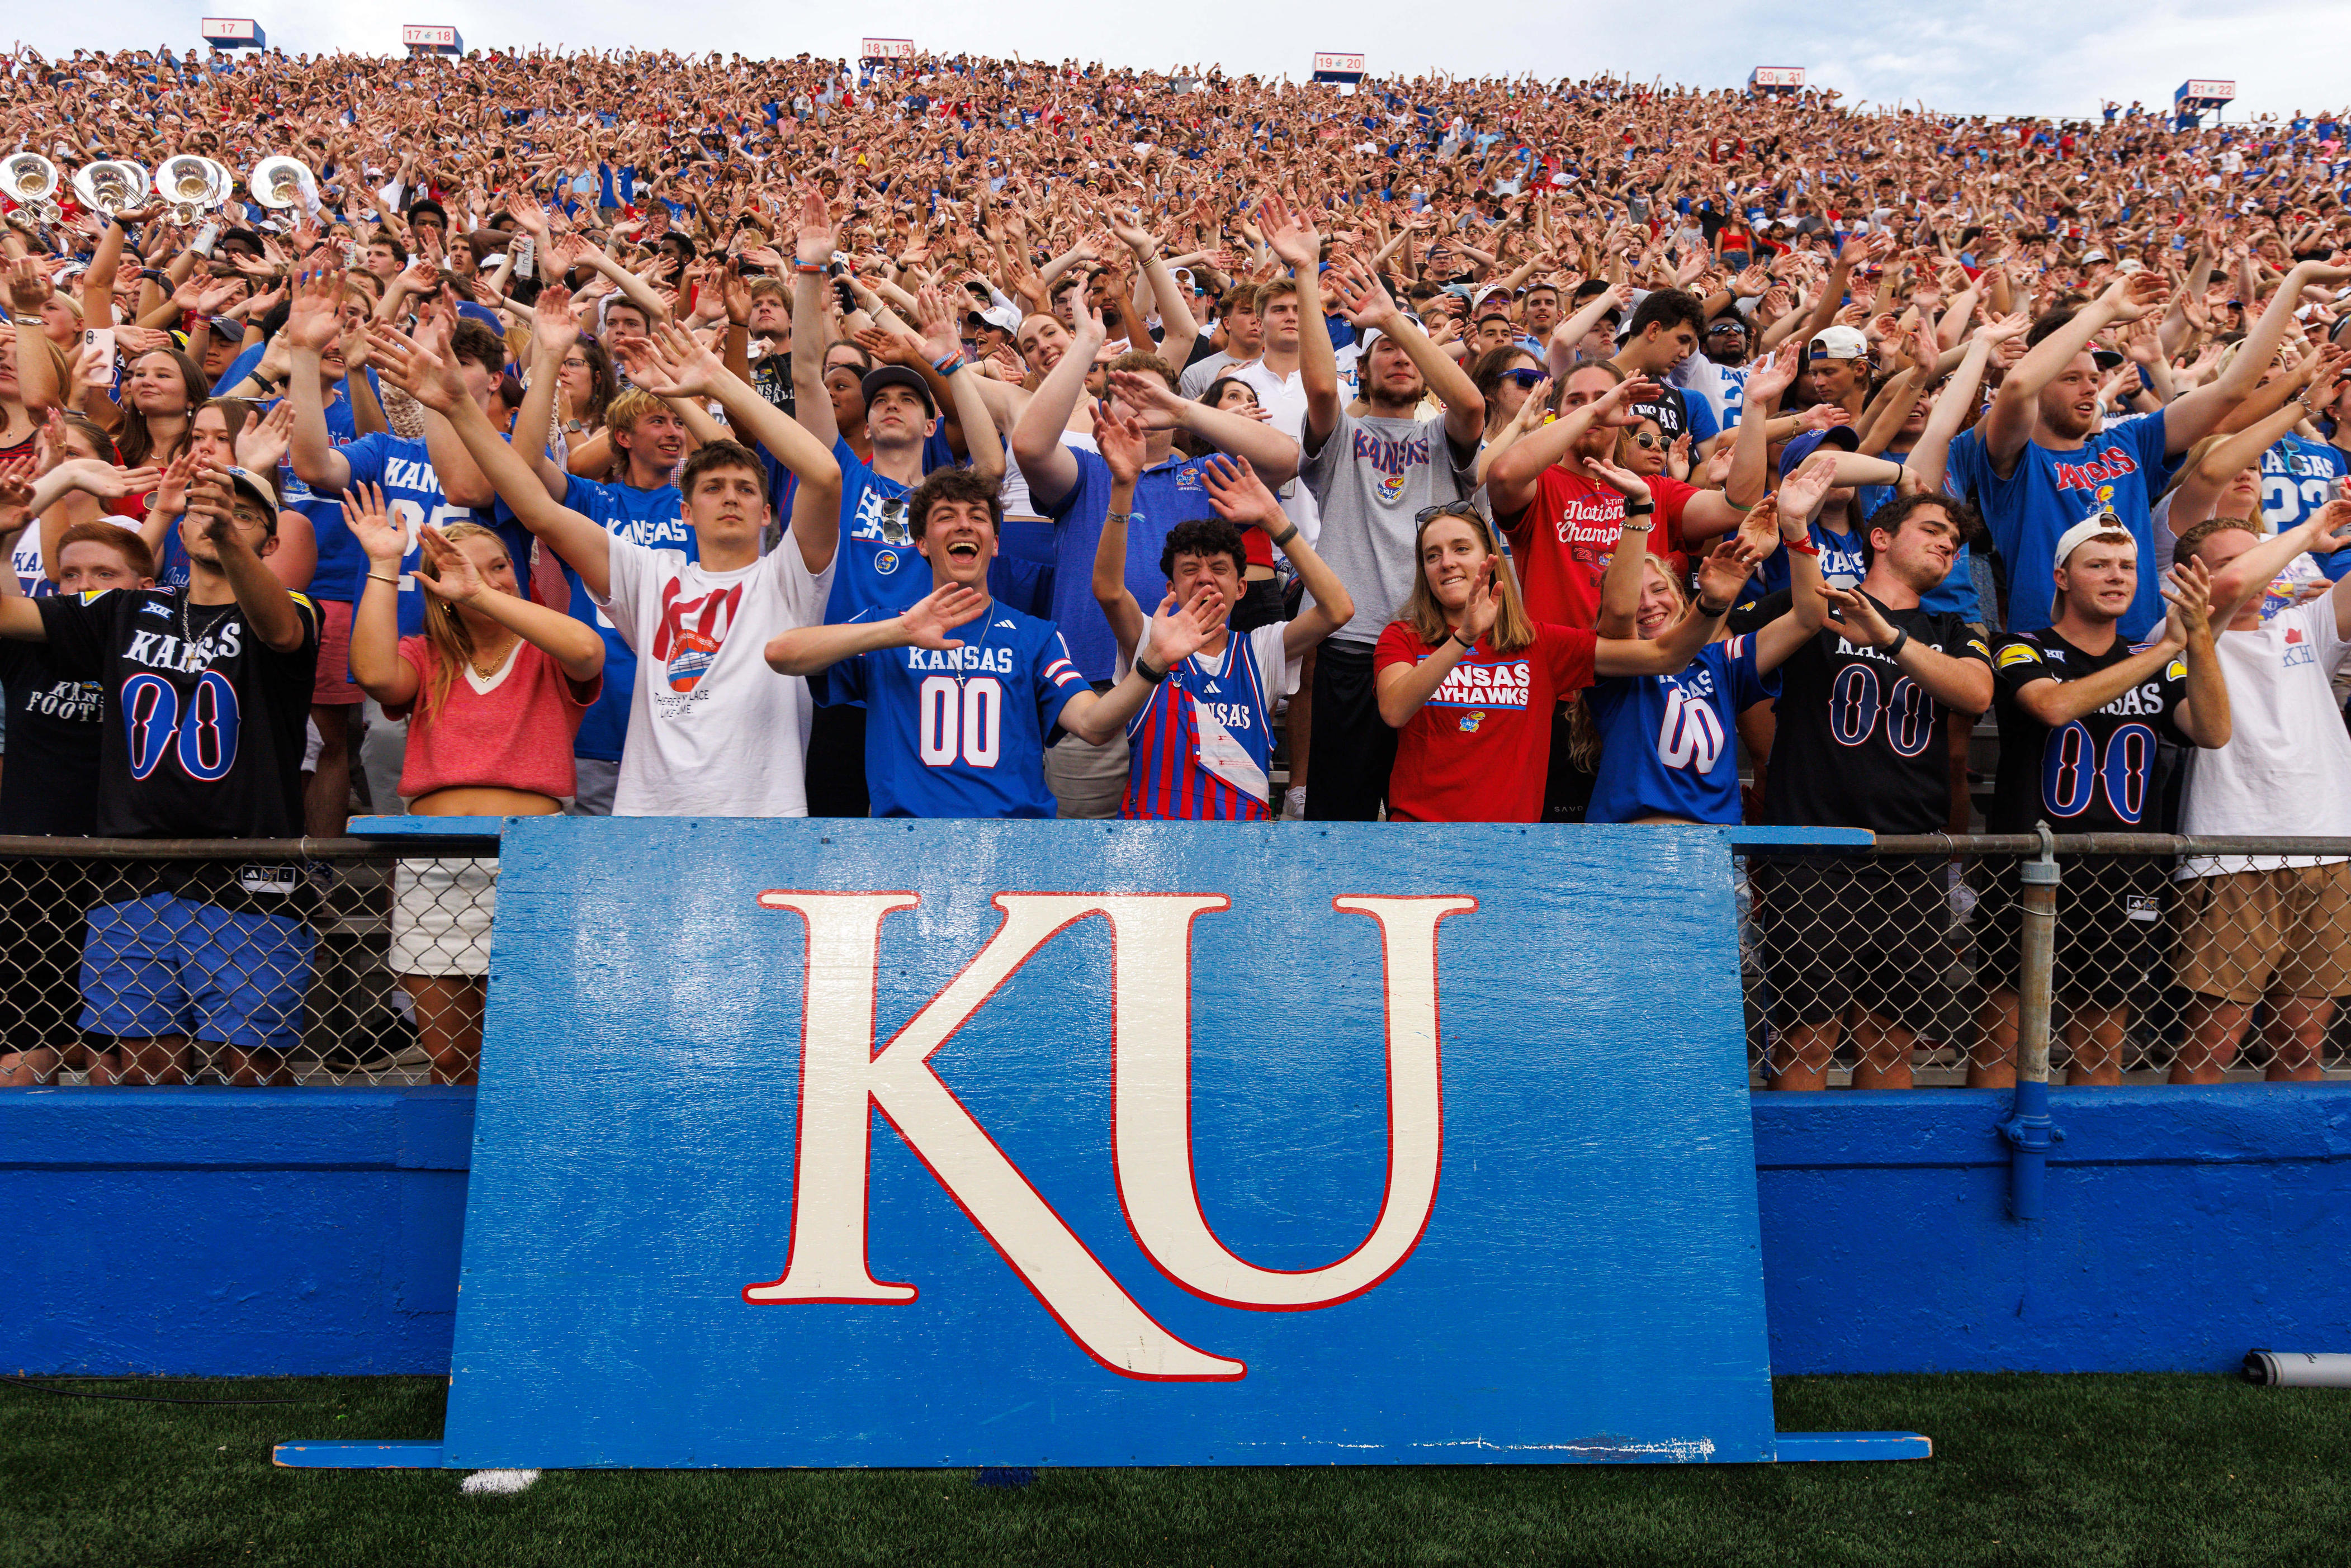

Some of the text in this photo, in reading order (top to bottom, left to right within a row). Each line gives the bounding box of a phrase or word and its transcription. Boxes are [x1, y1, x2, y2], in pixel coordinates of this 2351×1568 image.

[221, 23, 235, 33] 17
[407, 30, 451, 41] 17 18
[867, 44, 880, 53] 18
[895, 45, 909, 54] 19
[1319, 58, 1361, 68] 19 20
[1760, 72, 1773, 81] 20
[1789, 73, 1800, 82] 21
[2193, 84, 2232, 95] 21 22
[385, 456, 444, 495] KAN
[606, 518, 688, 546] KANSAS
[122, 622, 242, 673] KANSS
[907, 645, 1013, 673] KANSAS
[2283, 644, 2314, 667] KH
[1443, 663, 1530, 688] ANSAS
[49, 680, 103, 704] KAN
[689, 690, 709, 701] LACE
[1428, 685, 1529, 705] AYHAWKS
[920, 675, 1002, 769] 00
[1828, 662, 1937, 759] 00
[121, 669, 242, 782] 00
[1657, 687, 1725, 774] 00
[2041, 719, 2157, 825] 00
[741, 889, 1479, 1382] KU
